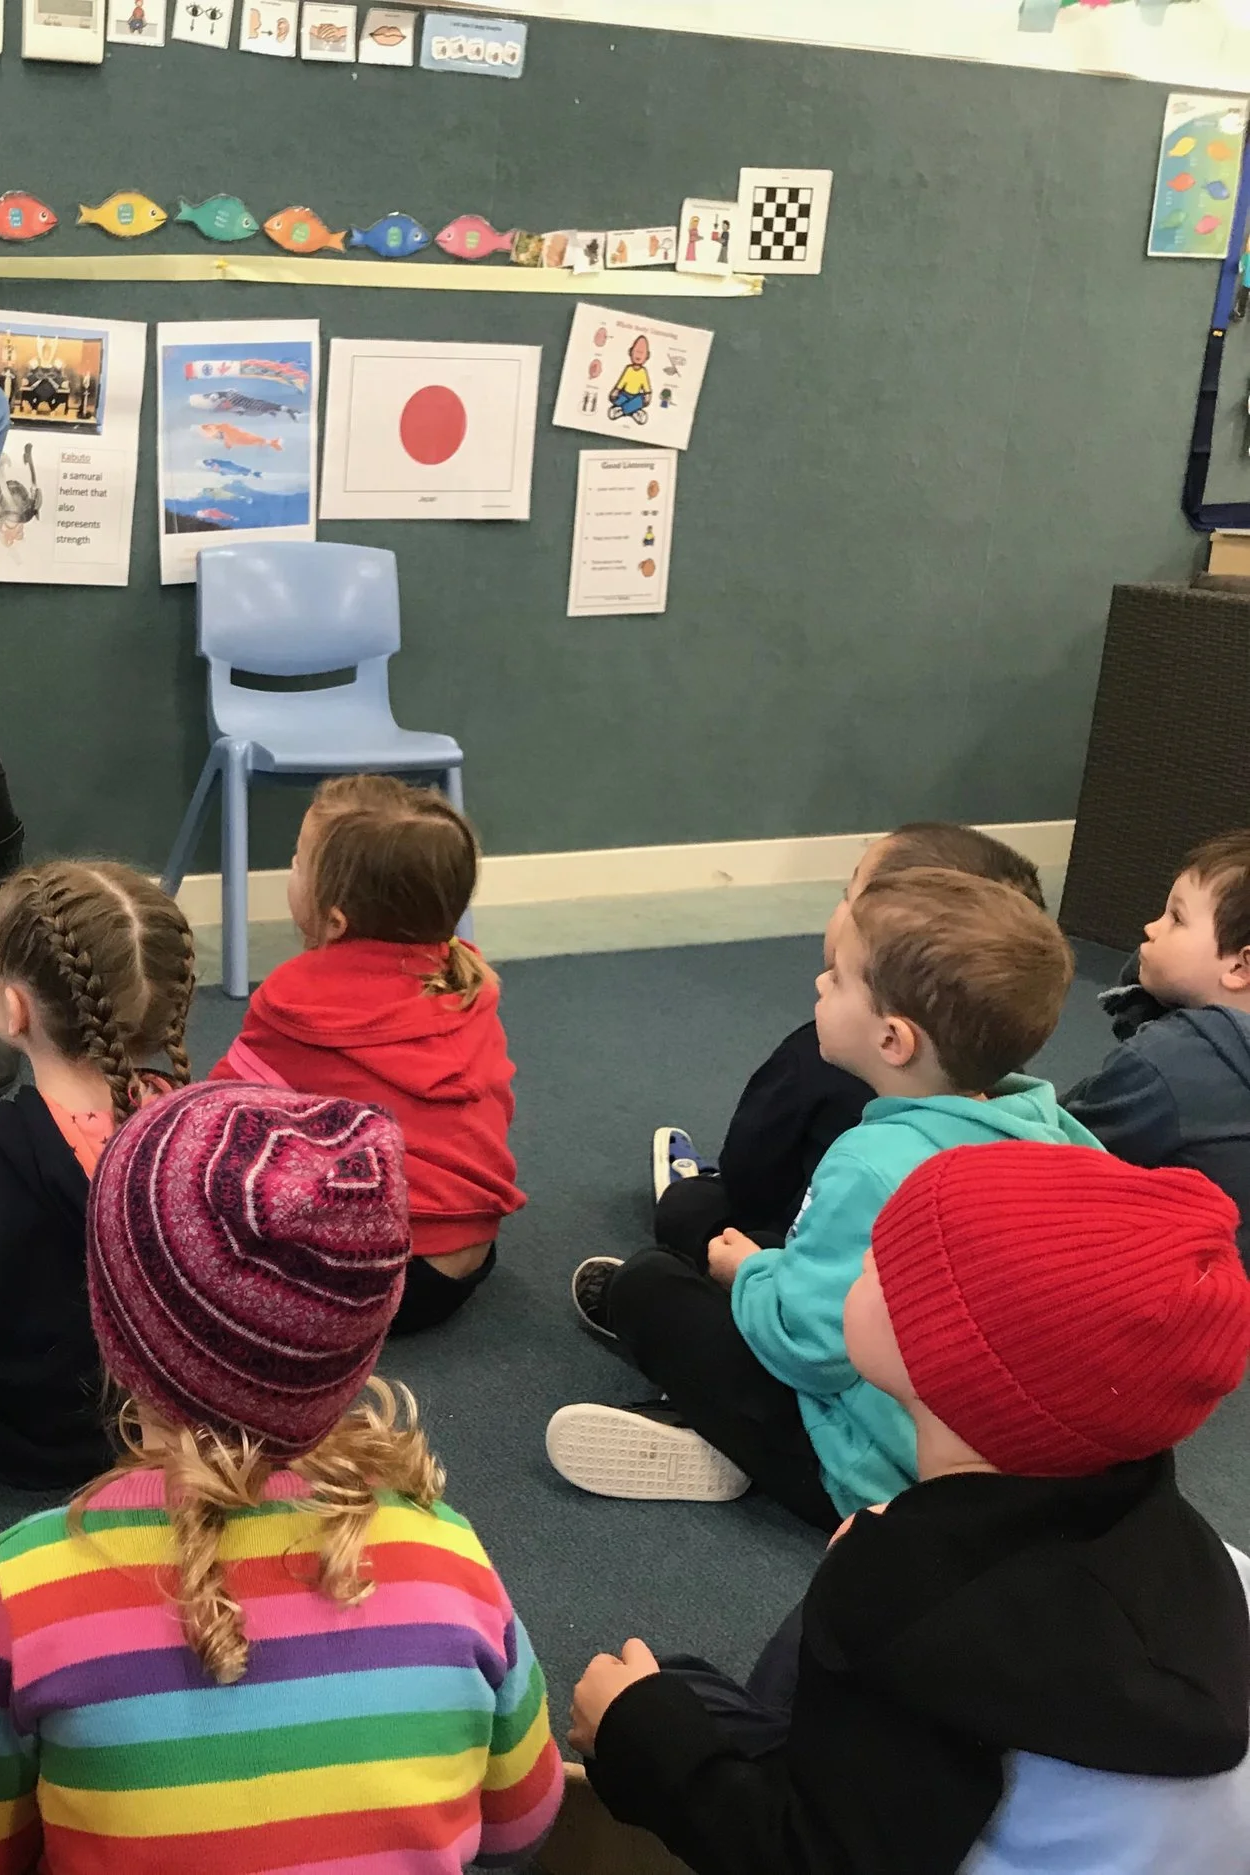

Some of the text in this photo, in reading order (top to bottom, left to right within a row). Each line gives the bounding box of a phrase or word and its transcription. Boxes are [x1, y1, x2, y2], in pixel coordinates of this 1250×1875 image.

[61, 452, 91, 463] Kabuto
[69, 472, 103, 481] samurai
[59, 487, 107, 497] helmet that
[58, 503, 75, 512] also
[57, 520, 101, 530] represents
[56, 535, 91, 546] strength
